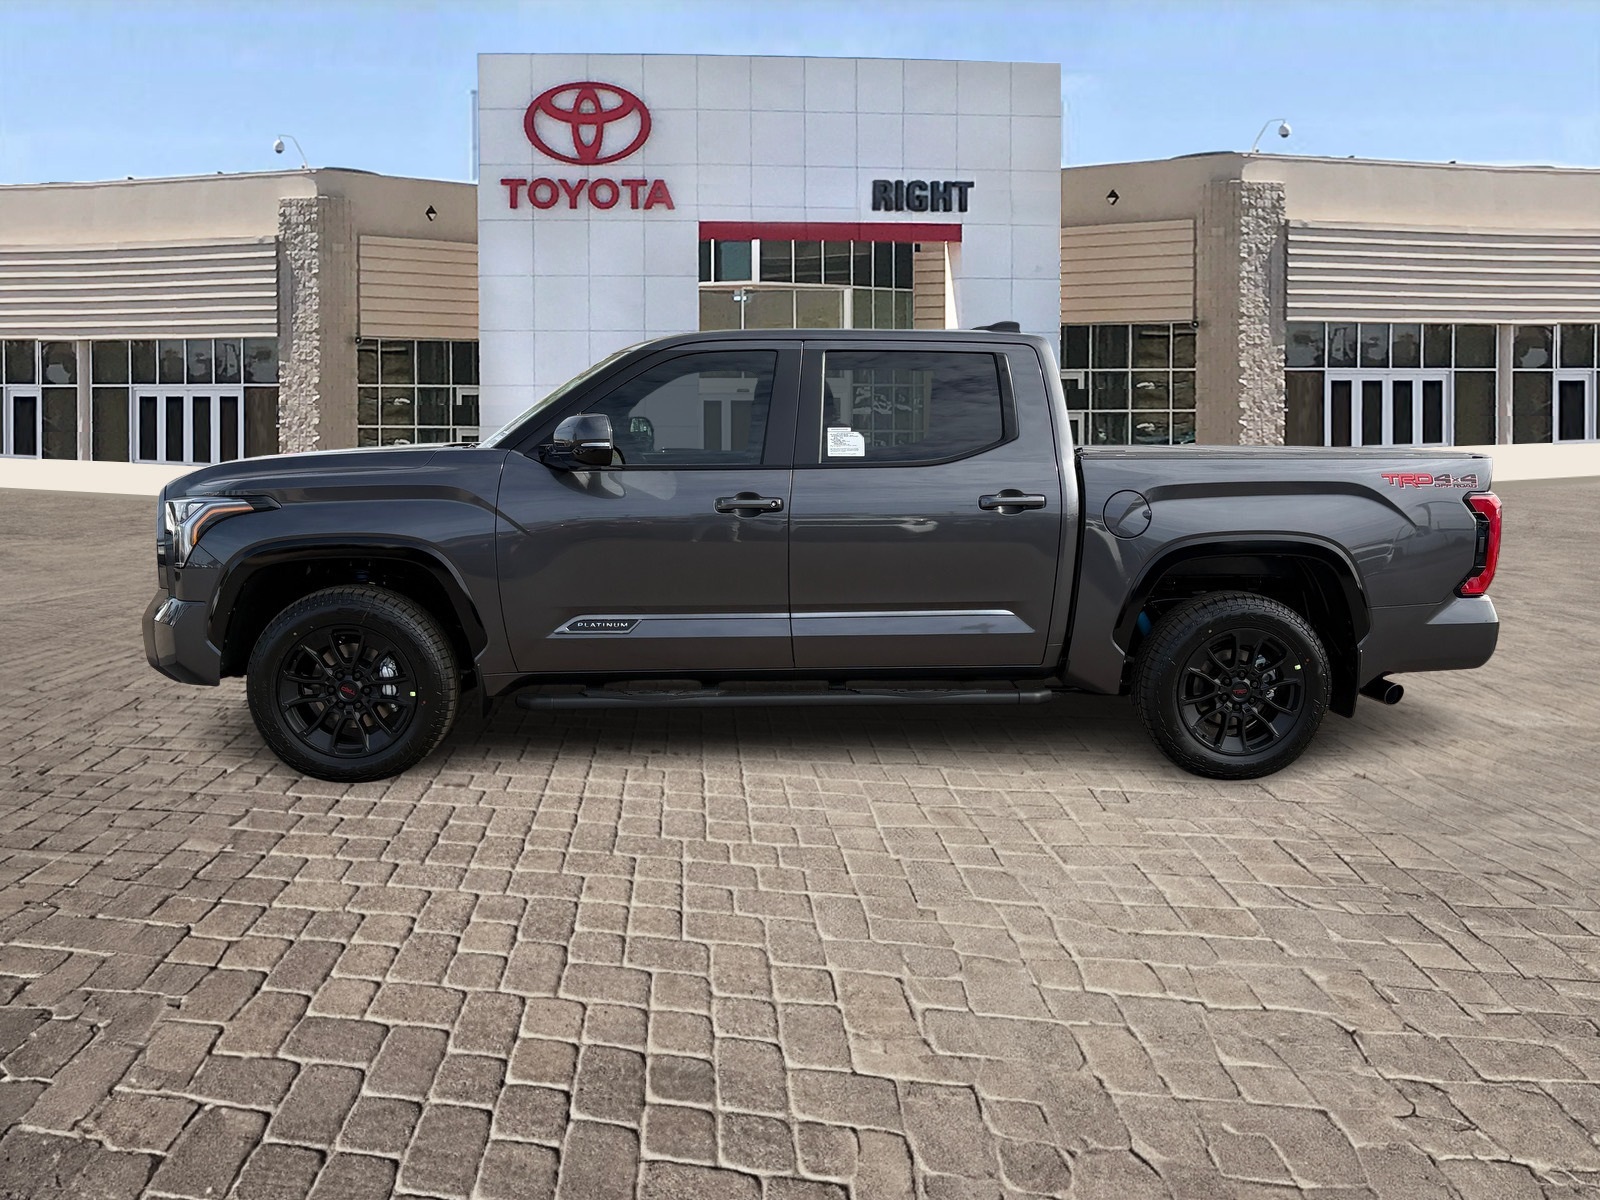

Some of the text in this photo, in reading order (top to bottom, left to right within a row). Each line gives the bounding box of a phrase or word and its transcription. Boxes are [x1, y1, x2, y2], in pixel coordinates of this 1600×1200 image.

[501, 178, 674, 209] TOYOTA
[871, 180, 975, 212] RIGHT
[1381, 473, 1433, 488] TRD
